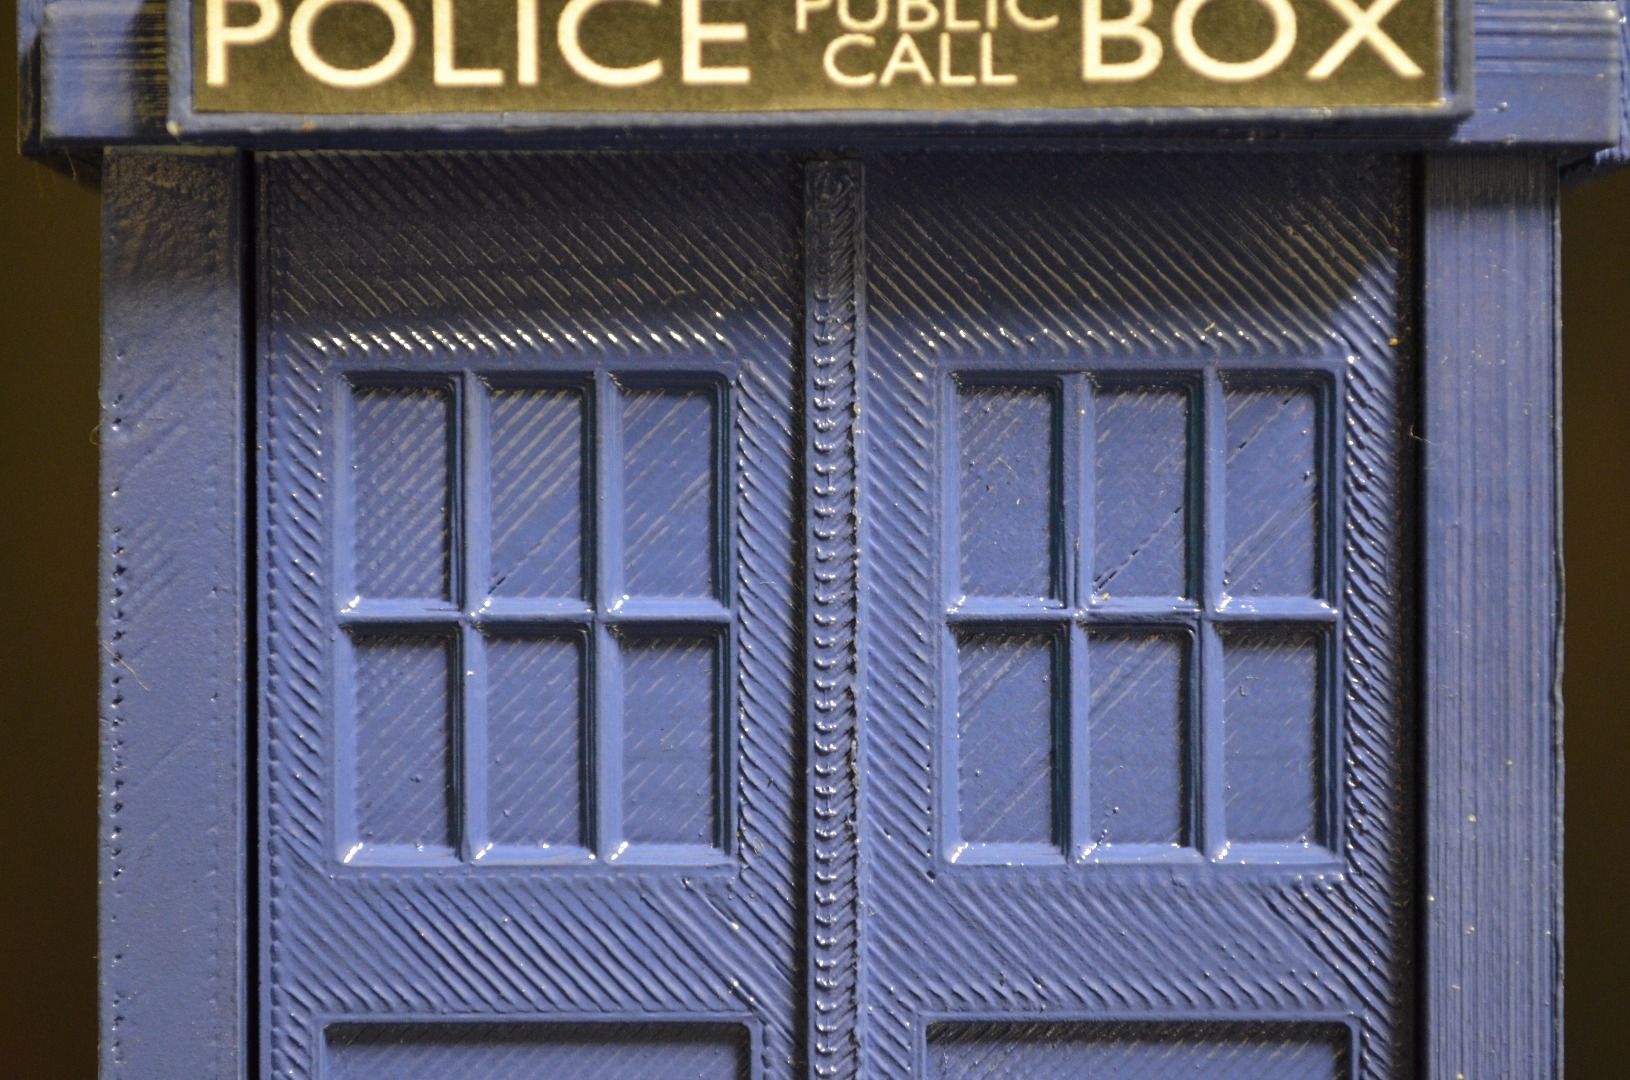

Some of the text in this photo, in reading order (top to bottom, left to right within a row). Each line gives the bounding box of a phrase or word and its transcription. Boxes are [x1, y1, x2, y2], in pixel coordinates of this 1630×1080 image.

[206, 0, 751, 87] POLICE
[823, 33, 1018, 86] CALL
[1082, 0, 1423, 81] BOX
